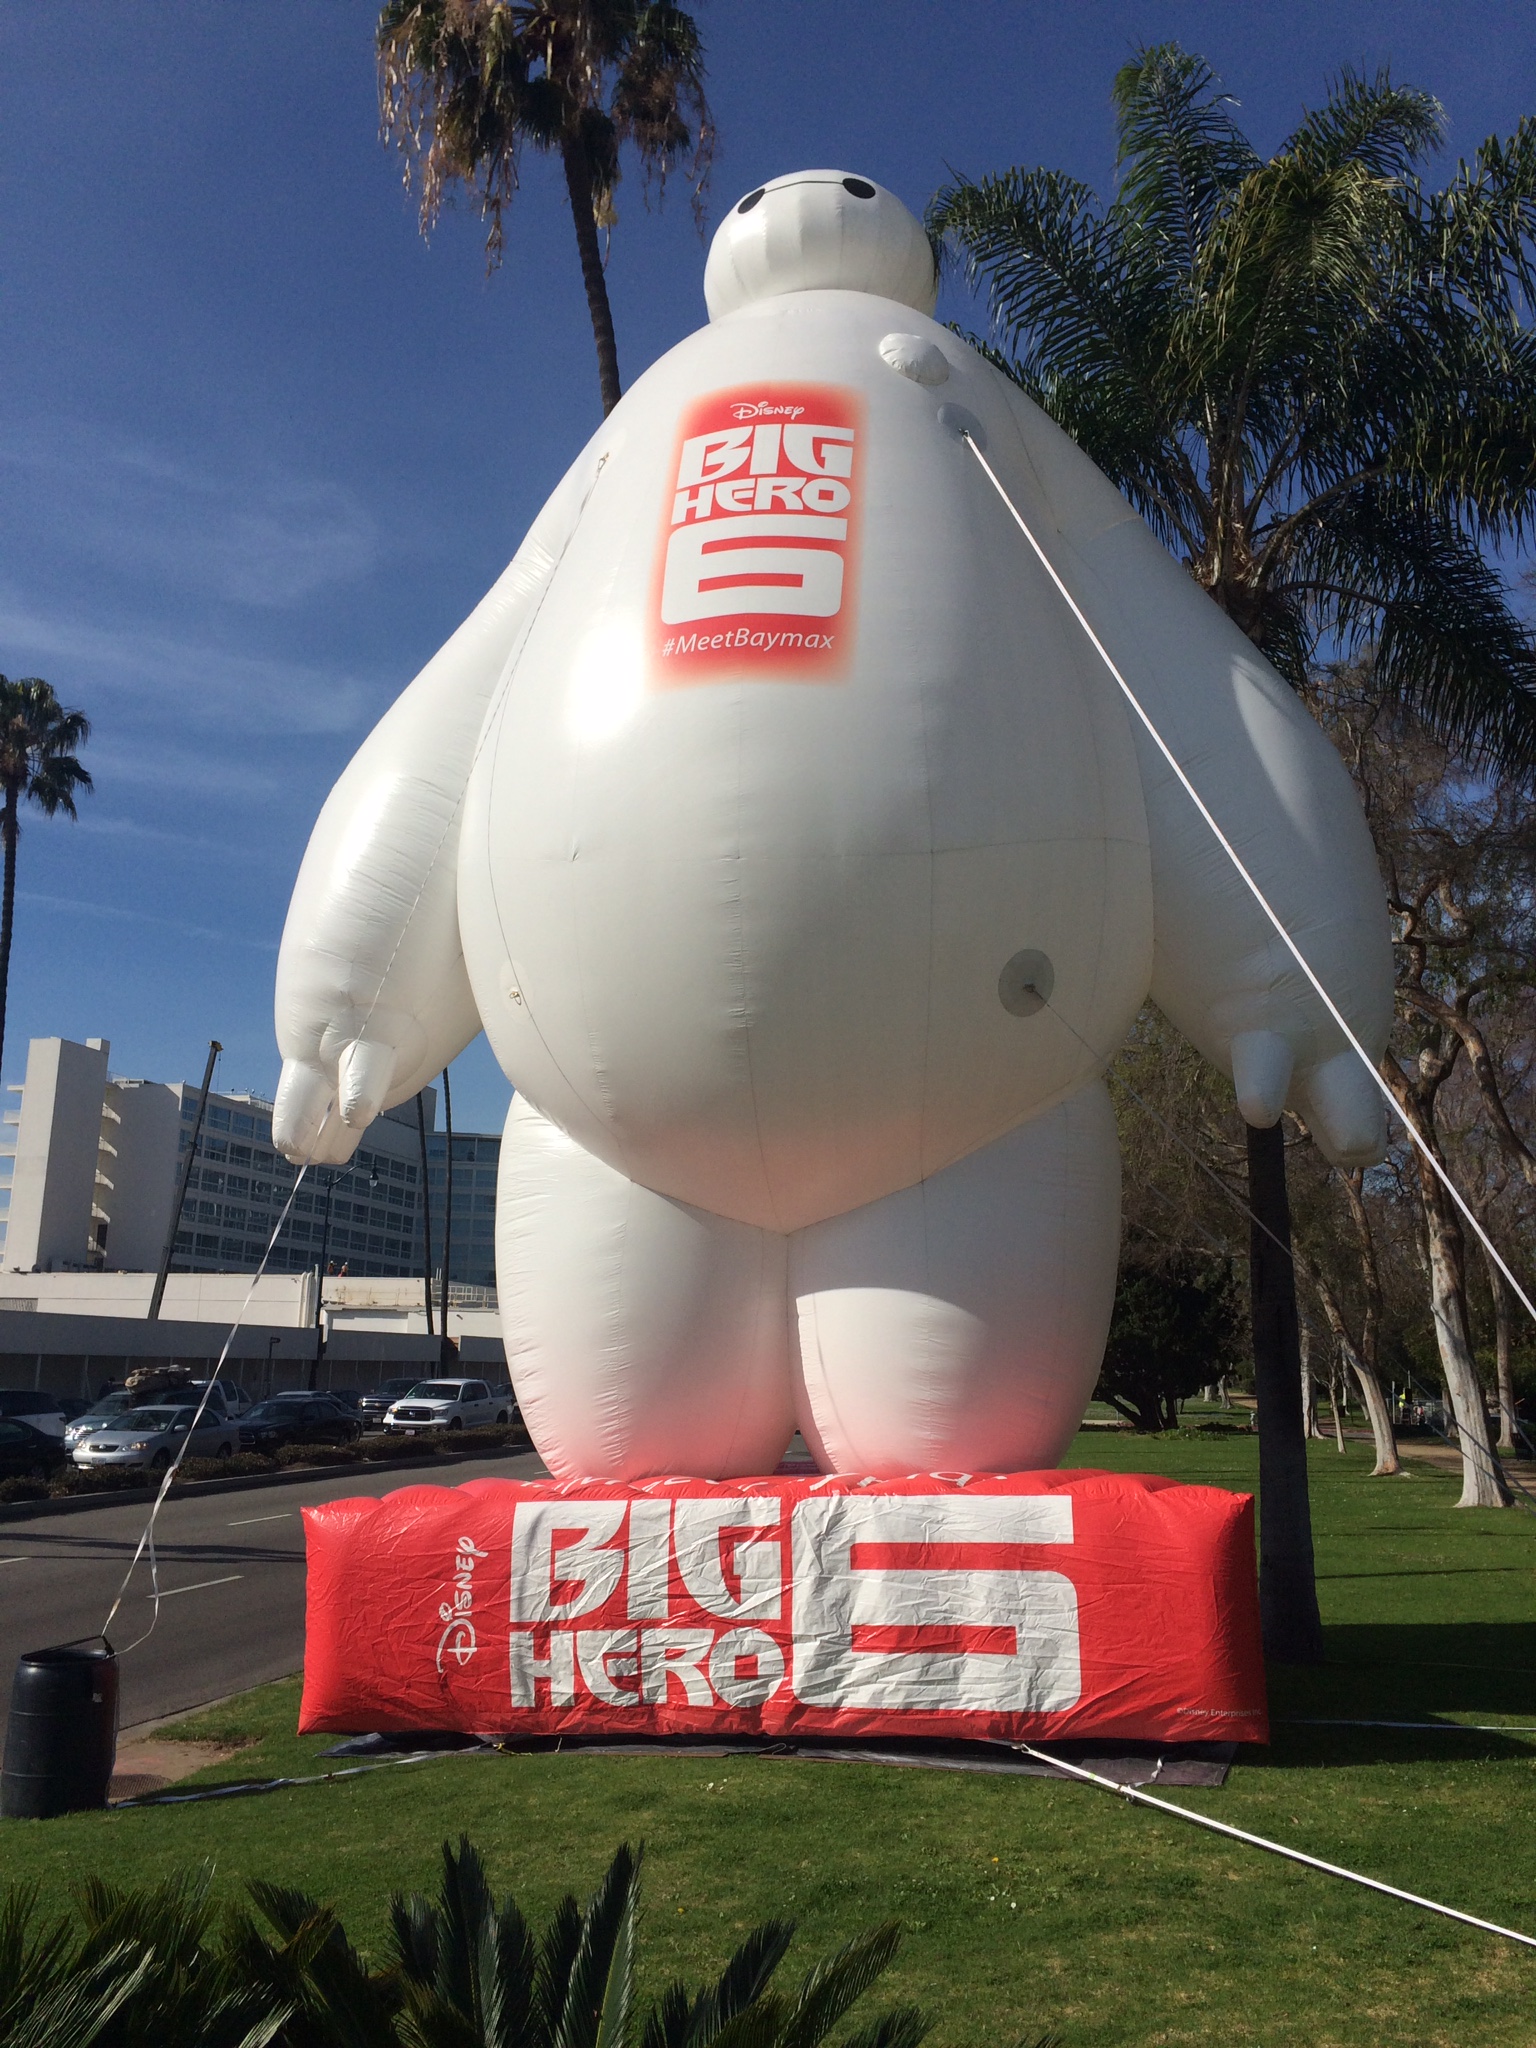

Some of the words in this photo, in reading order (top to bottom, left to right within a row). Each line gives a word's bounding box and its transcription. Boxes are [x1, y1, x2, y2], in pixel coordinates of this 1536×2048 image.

[676, 423, 855, 490] BIG
[671, 477, 851, 526] HERO
[661, 514, 848, 625] 6
[662, 628, 835, 657] #MeetBaymax
[509, 1496, 782, 1622] BIG
[792, 1494, 1082, 1712] 6
[509, 1628, 785, 1708] HERO
[1210, 1708, 1252, 1718] Enterprises
